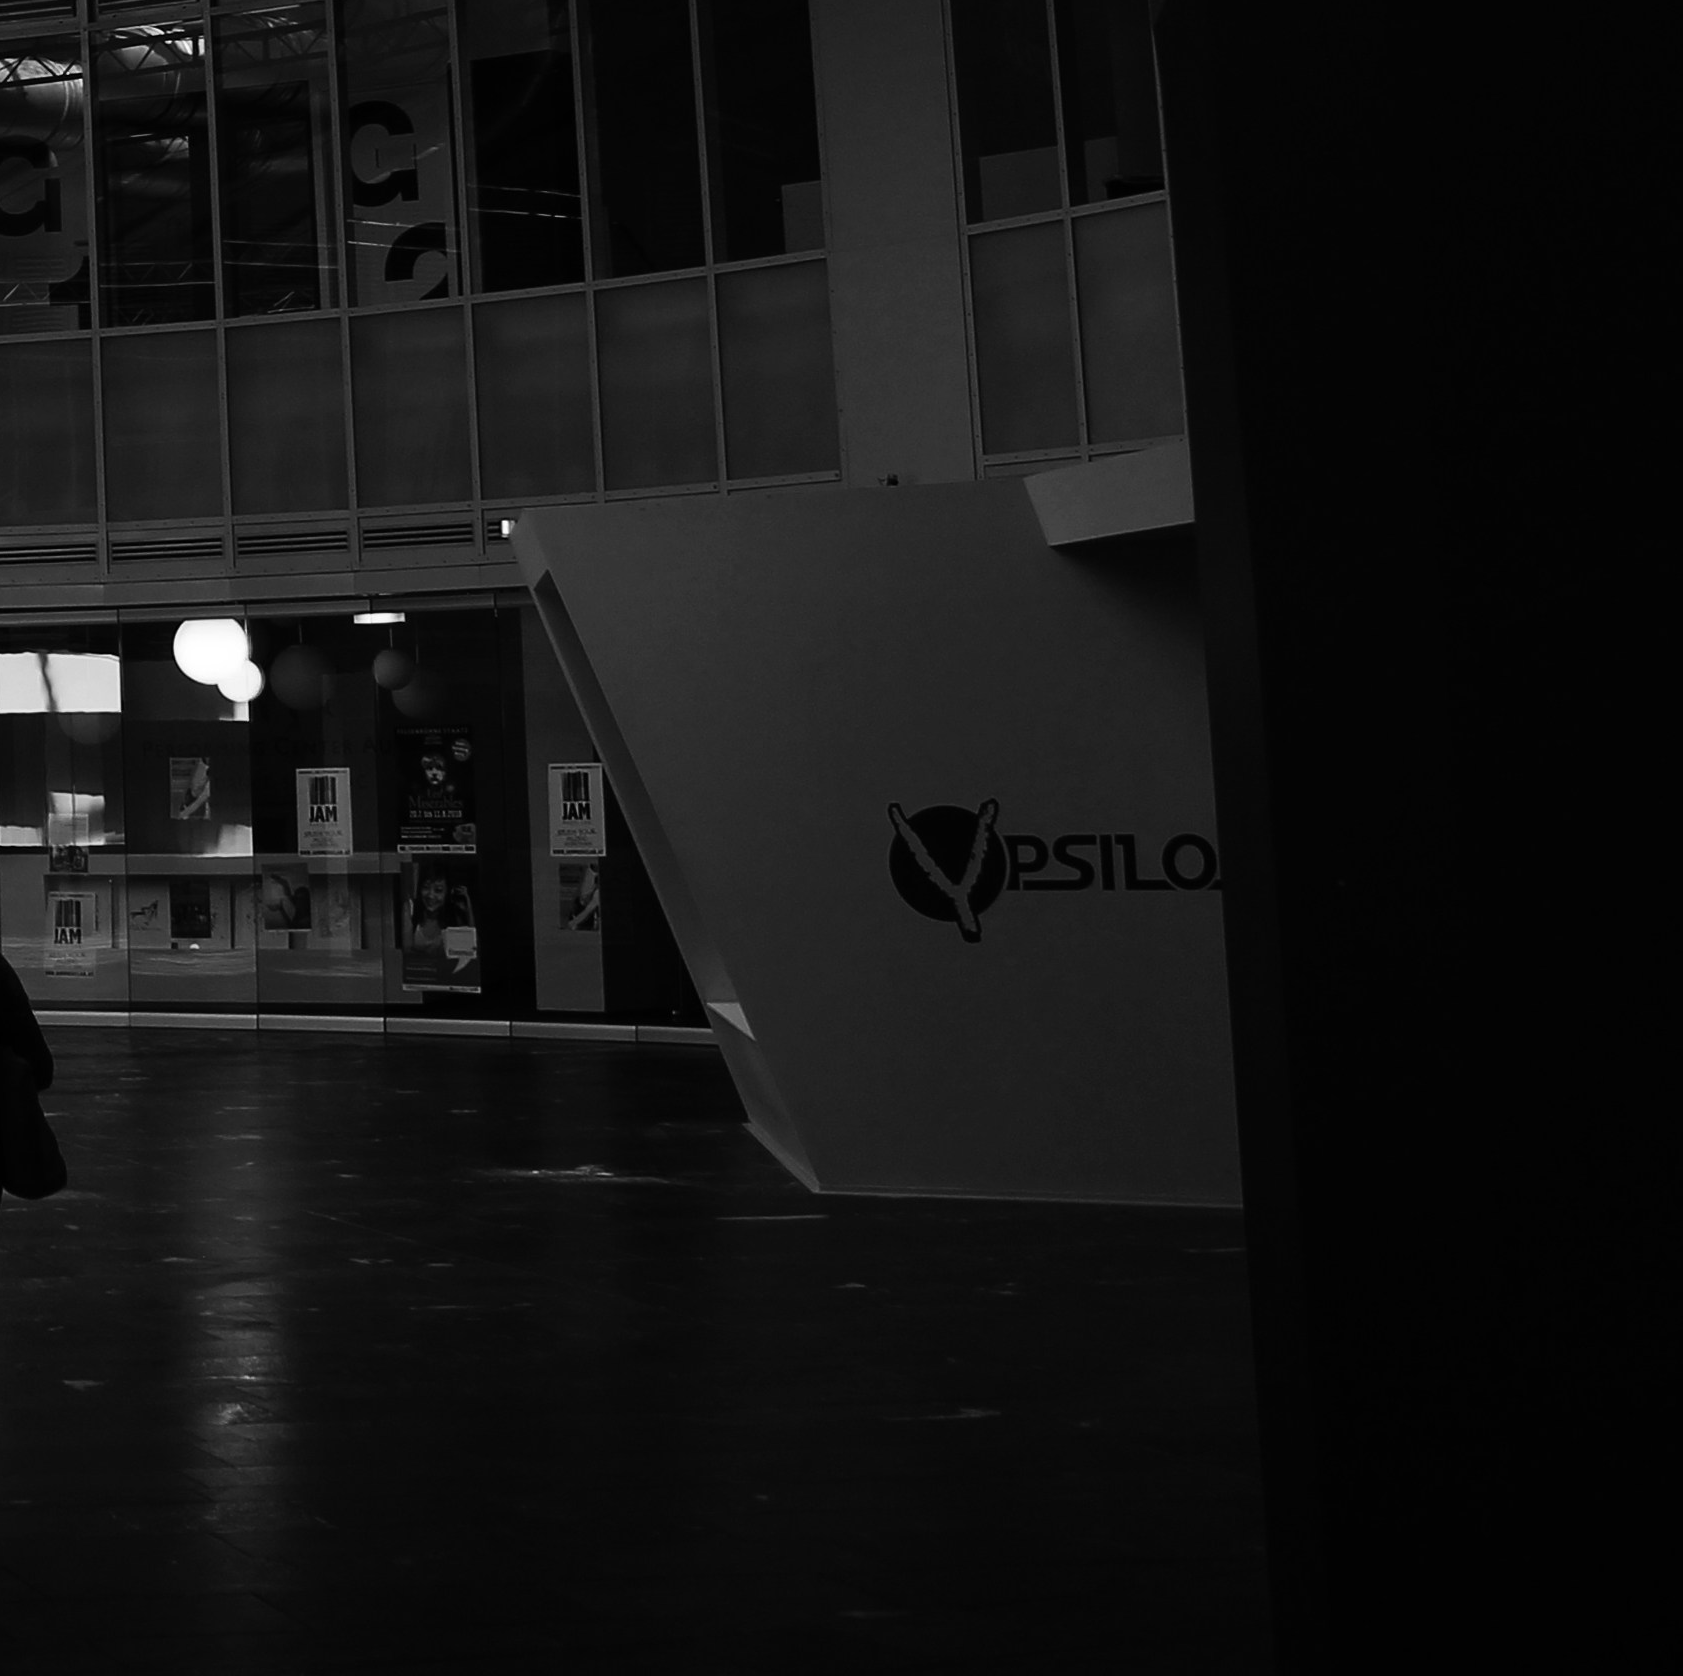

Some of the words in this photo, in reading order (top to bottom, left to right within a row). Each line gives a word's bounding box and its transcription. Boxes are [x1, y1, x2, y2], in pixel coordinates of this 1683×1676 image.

[309, 805, 338, 823] JAM
[562, 802, 591, 820] JAM
[54, 927, 82, 944] JAM
